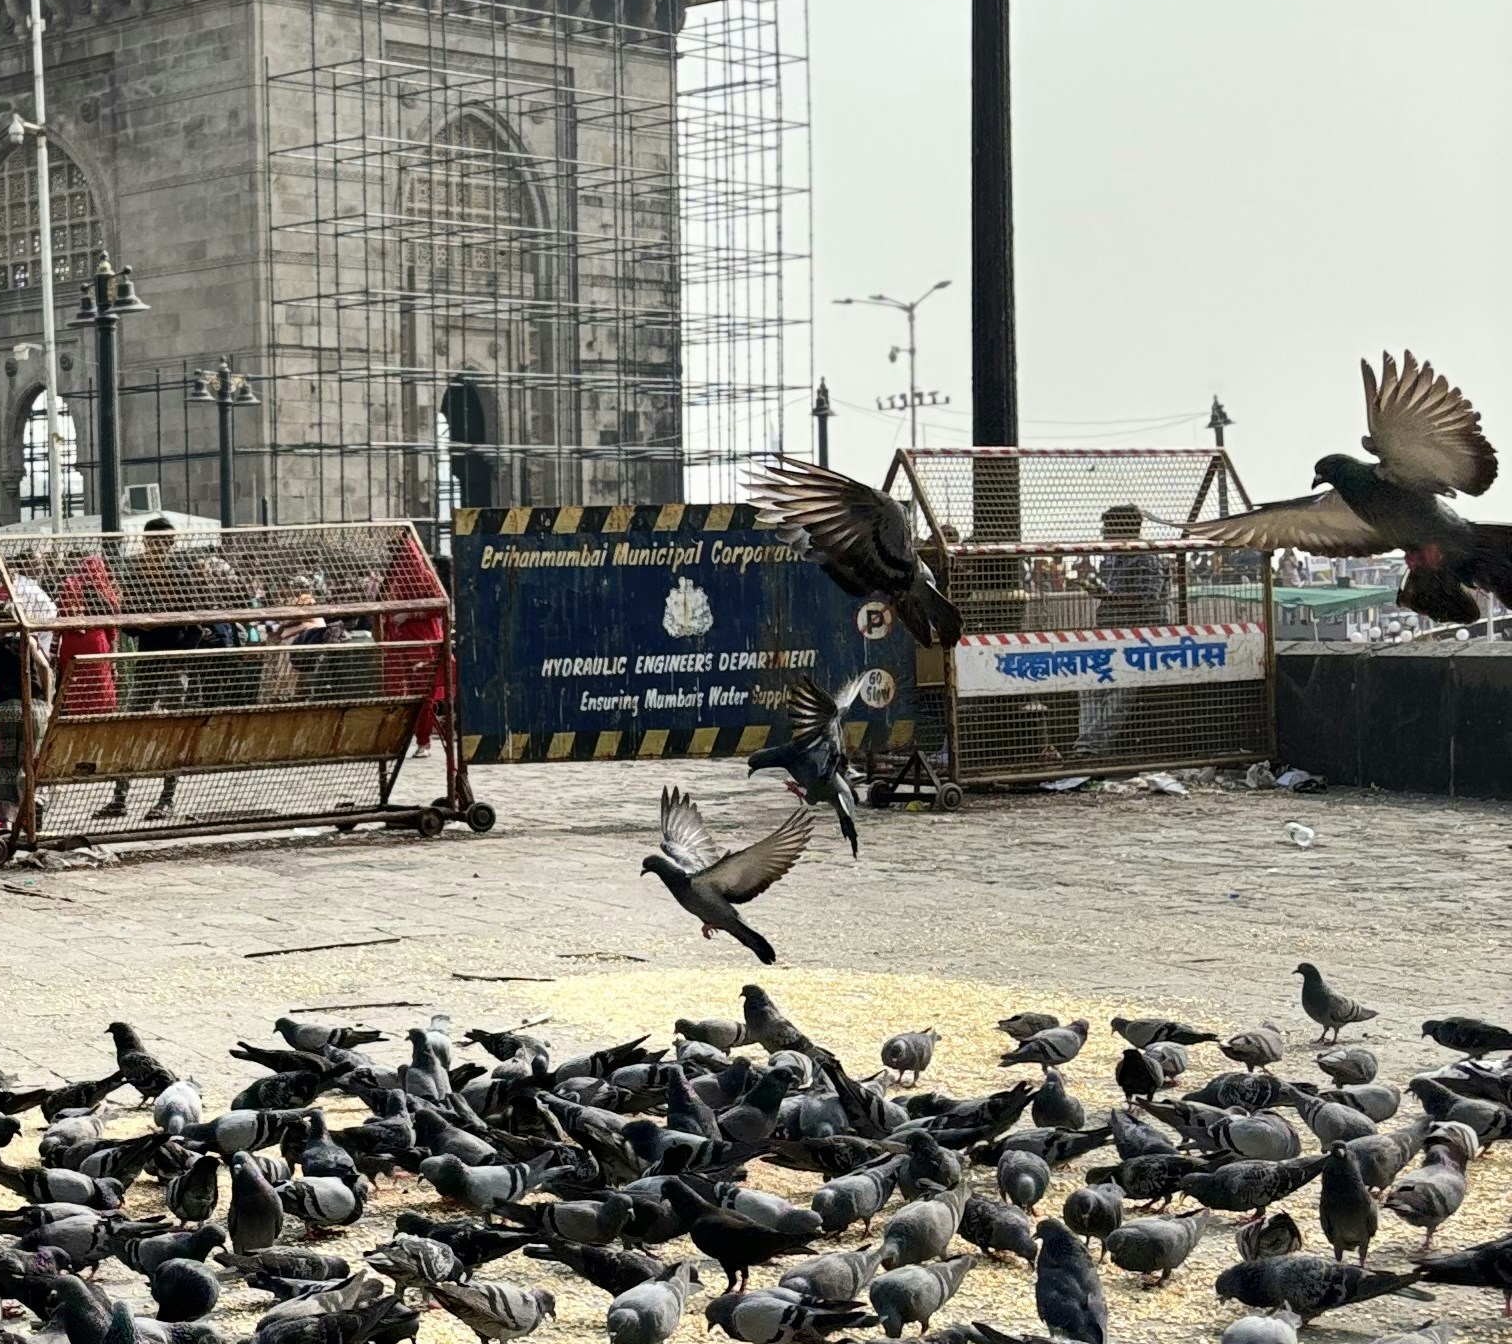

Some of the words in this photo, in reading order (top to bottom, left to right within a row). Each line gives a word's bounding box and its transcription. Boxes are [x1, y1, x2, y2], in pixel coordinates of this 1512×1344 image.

[481, 542, 609, 569] Brihanmumbai
[612, 540, 703, 574] Municipal
[541, 656, 628, 677] HYDRAULIC
[718, 648, 820, 672] DEPARTMENT
[1123, 636, 1228, 671] पोलीस
[579, 689, 640, 717] Ensuring
[708, 685, 749, 710] Water
